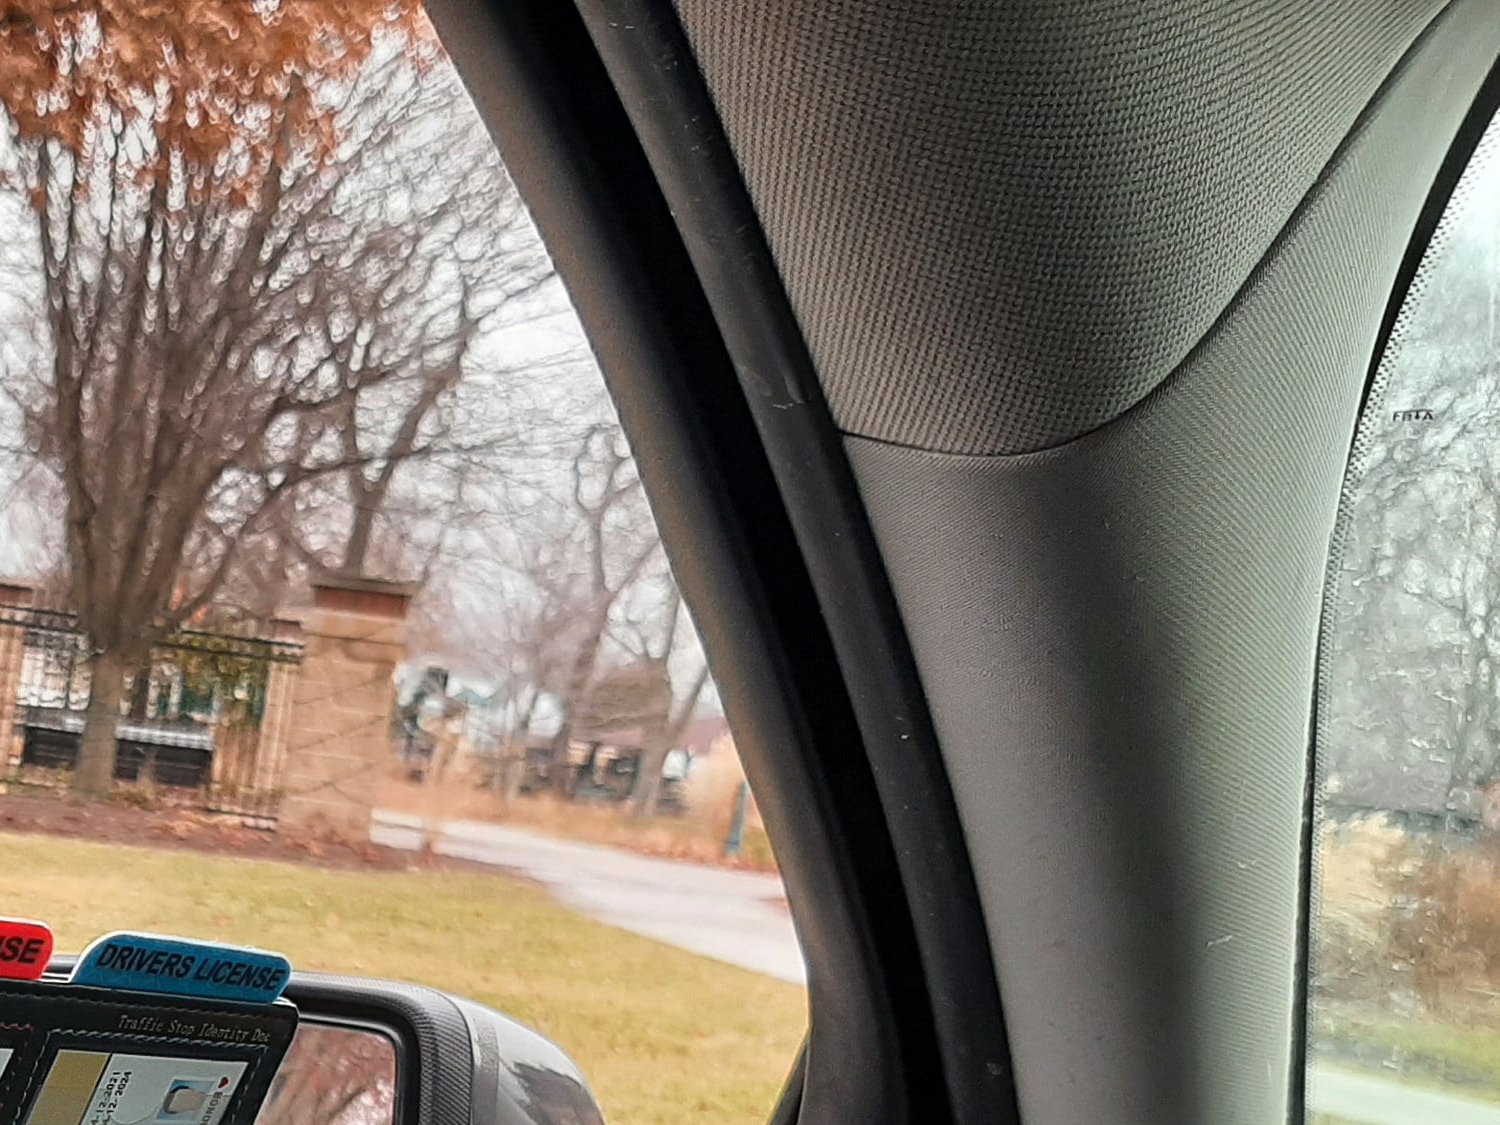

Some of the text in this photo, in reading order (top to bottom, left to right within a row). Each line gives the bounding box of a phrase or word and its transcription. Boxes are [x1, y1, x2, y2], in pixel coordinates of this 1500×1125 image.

[97, 944, 285, 990] DRIVERS LICENSE
[118, 1015, 163, 1033] Traffic
[168, 1019, 195, 1038] Stop
[199, 1023, 249, 1042] Identity
